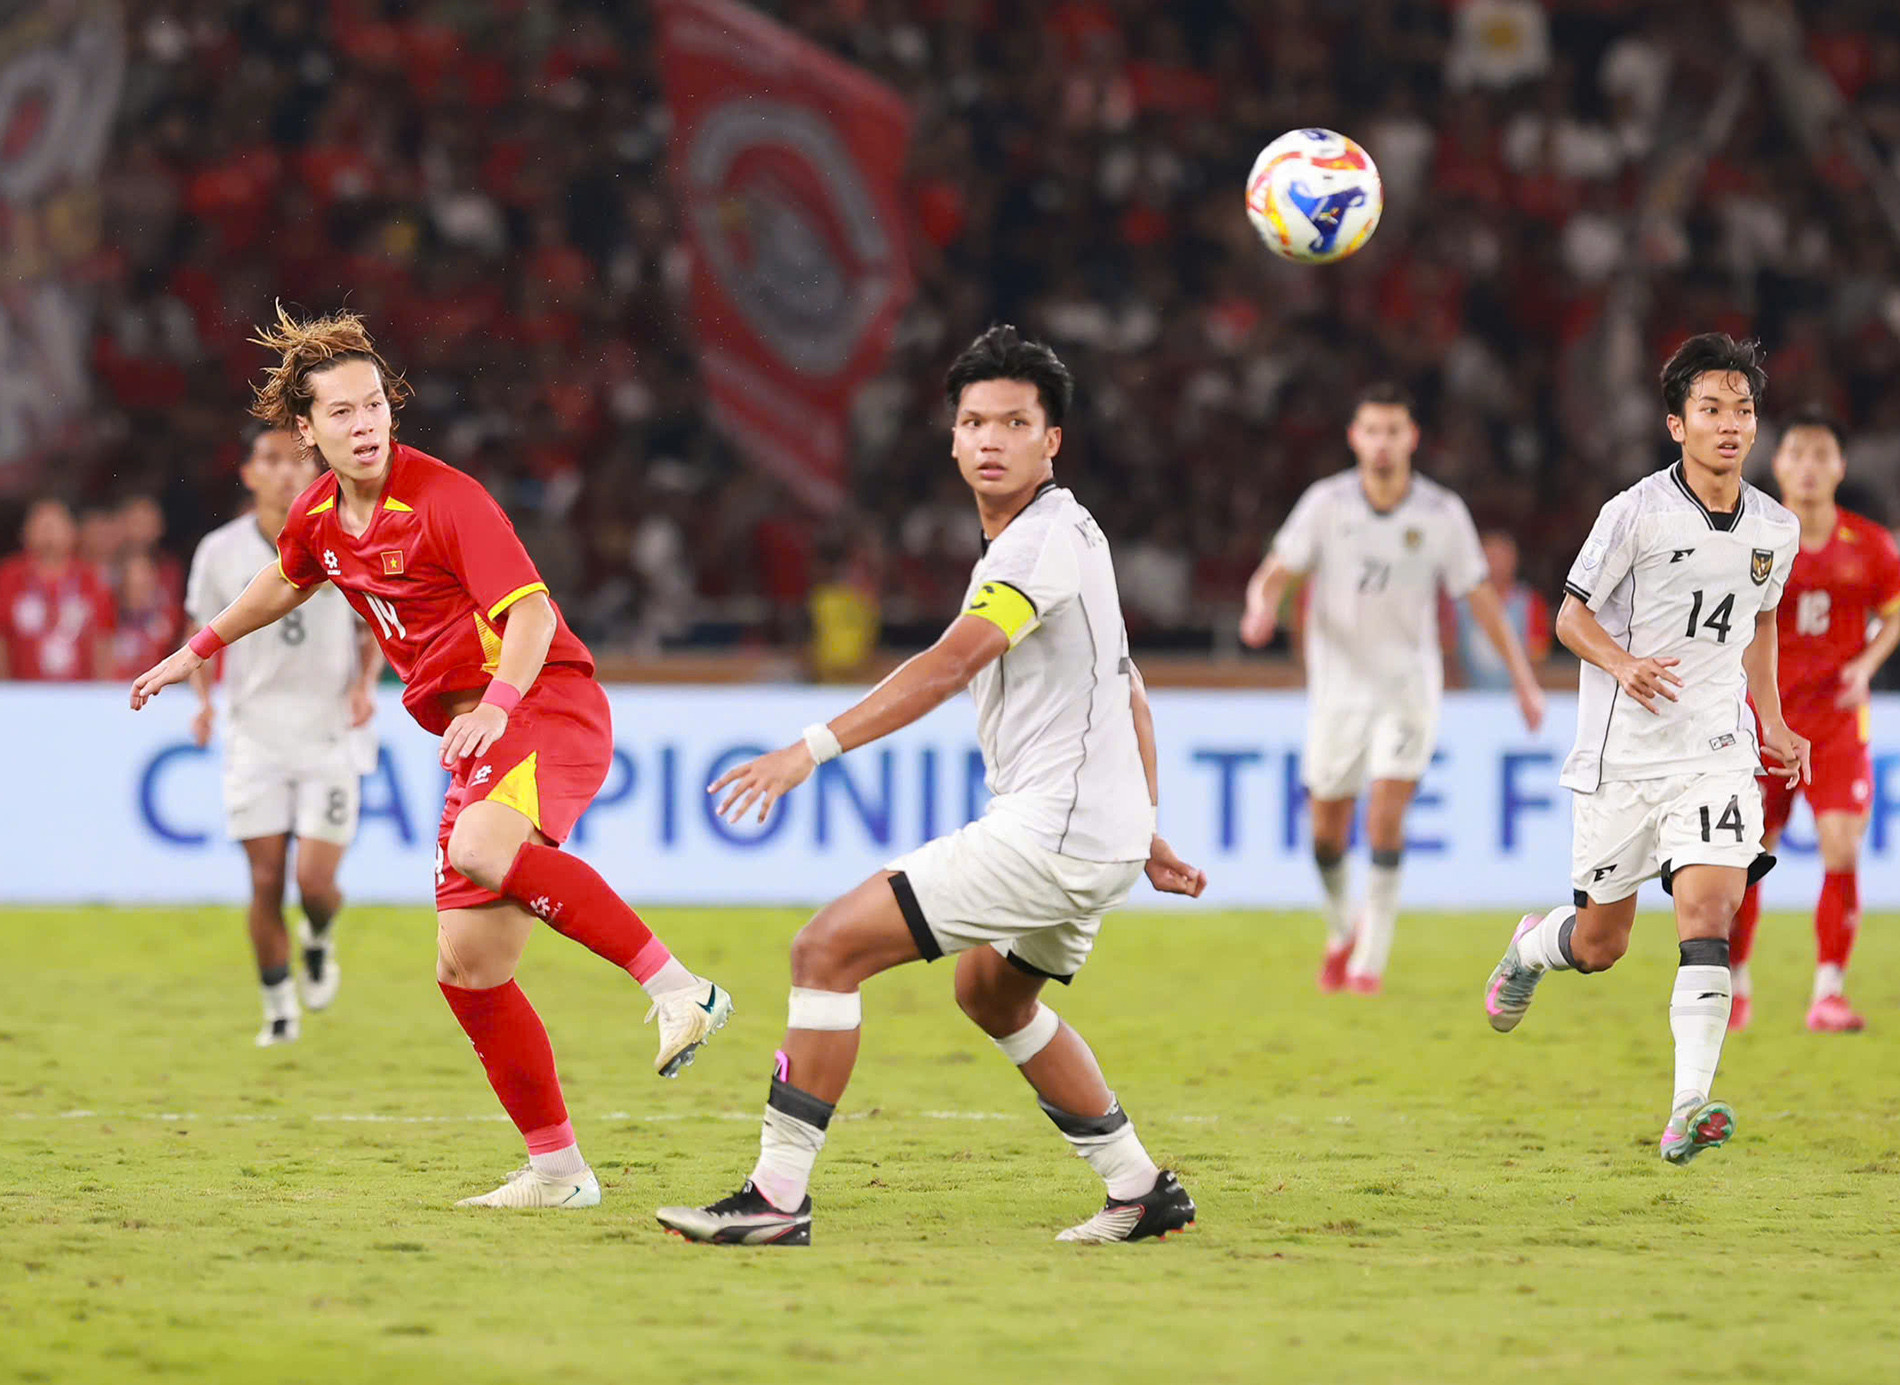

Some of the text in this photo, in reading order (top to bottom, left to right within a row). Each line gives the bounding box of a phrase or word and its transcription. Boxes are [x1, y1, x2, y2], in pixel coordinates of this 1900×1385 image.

[281, 608, 305, 646] 8
[361, 591, 407, 641] 14
[1685, 589, 1735, 644] 14
[325, 786, 348, 825] 8
[1699, 794, 1745, 843] 14
